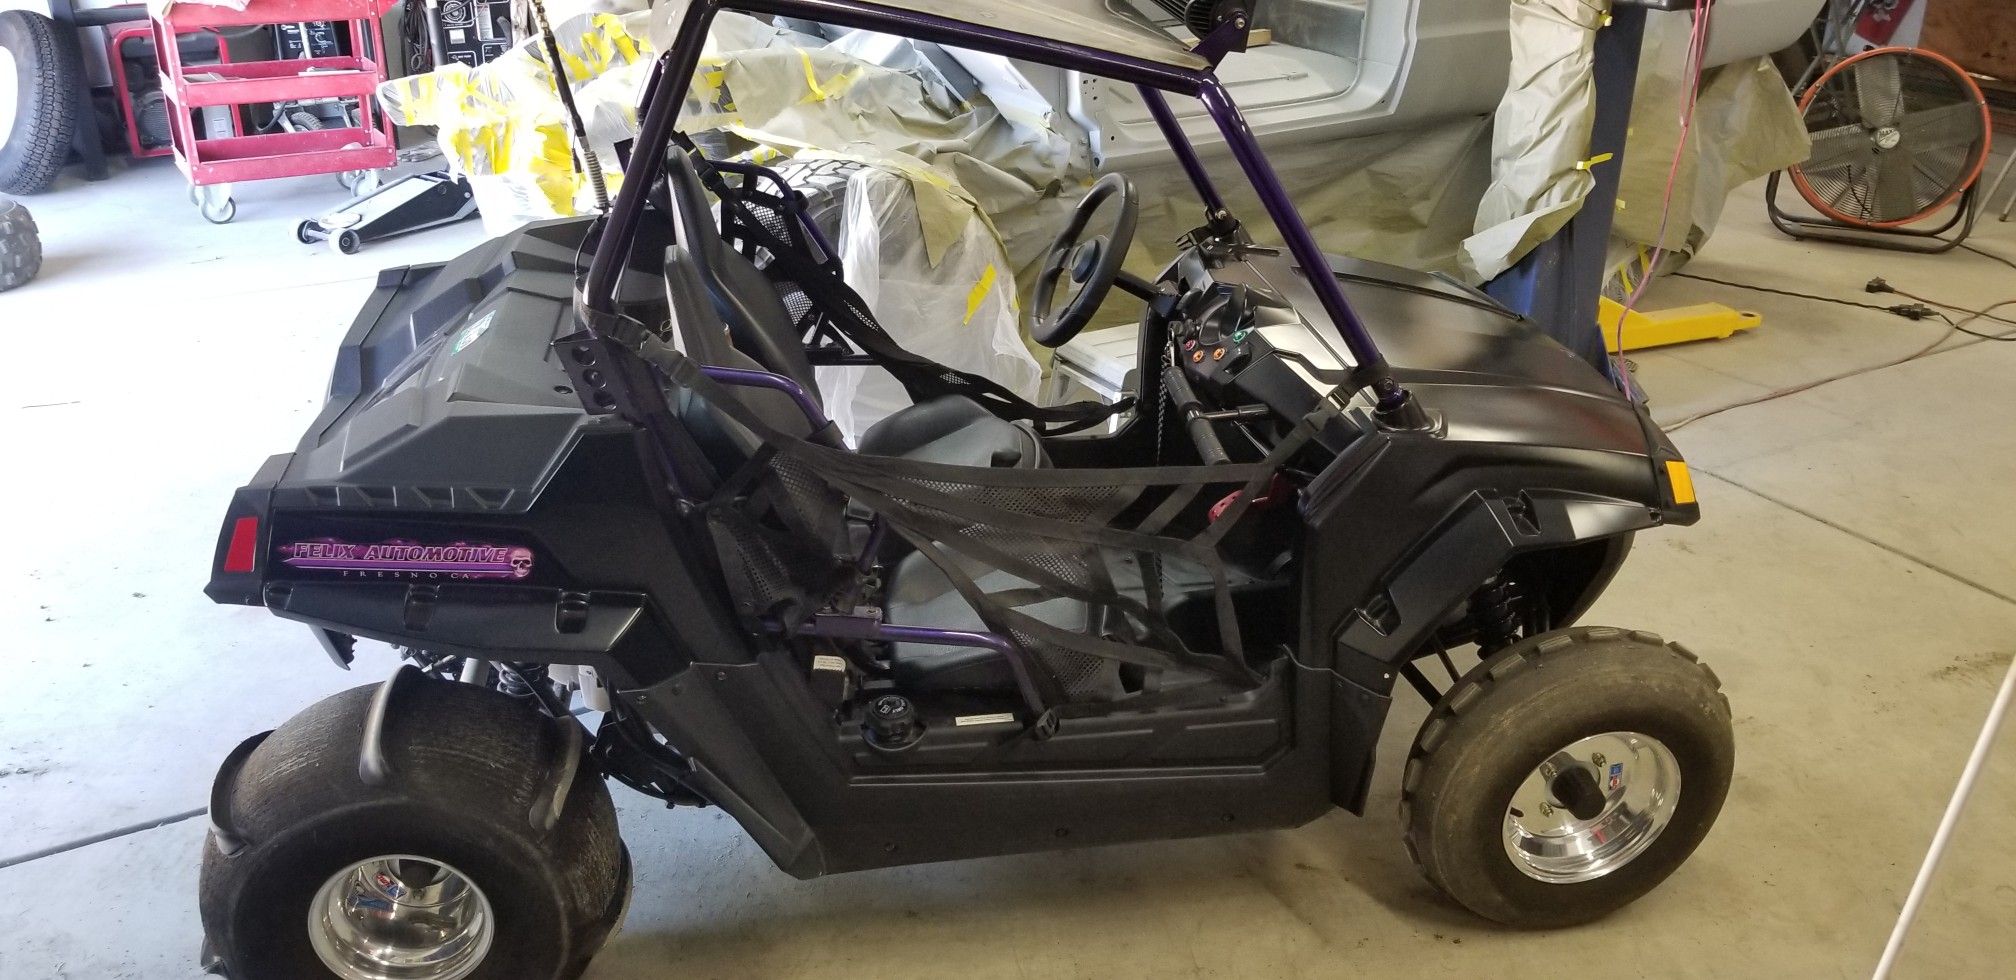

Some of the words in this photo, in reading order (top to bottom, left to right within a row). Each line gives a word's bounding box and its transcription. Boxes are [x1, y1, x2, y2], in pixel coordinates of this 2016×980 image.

[293, 542, 356, 560] FELIX
[363, 545, 508, 563] AUTOMOTIVE
[343, 570, 438, 579] FRESNO
